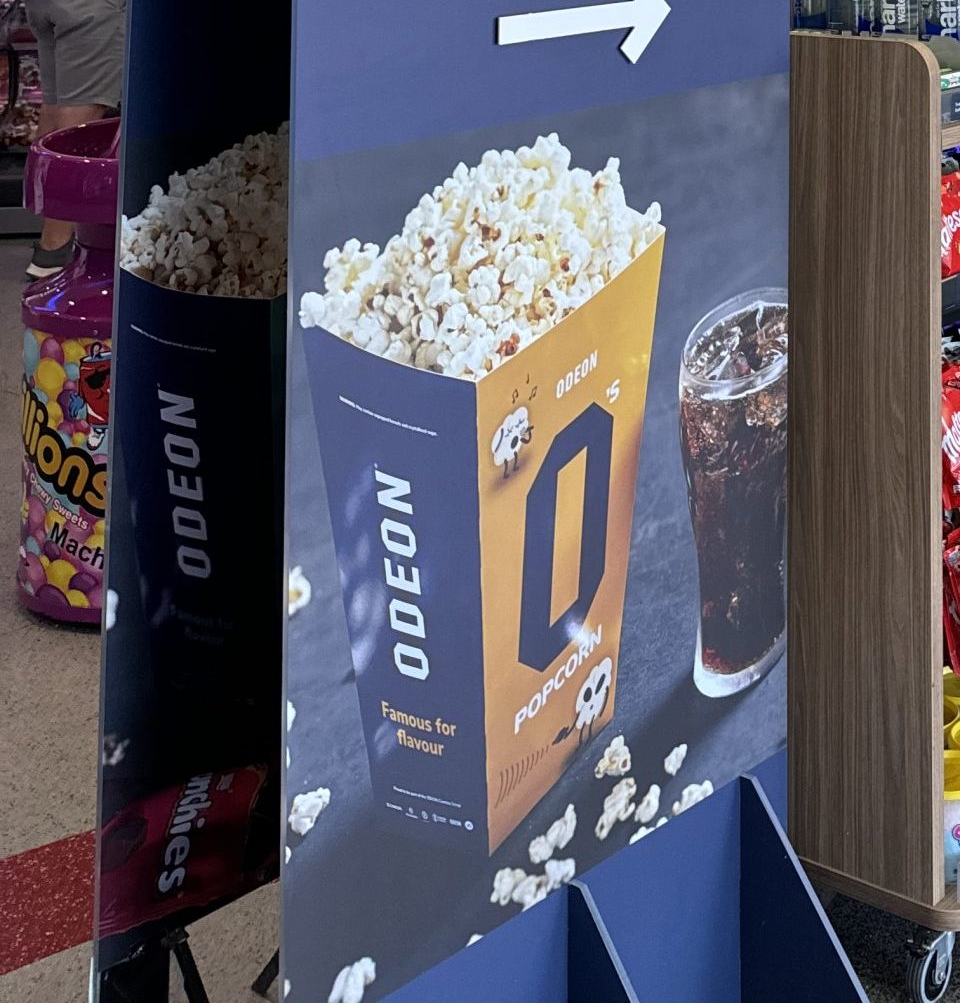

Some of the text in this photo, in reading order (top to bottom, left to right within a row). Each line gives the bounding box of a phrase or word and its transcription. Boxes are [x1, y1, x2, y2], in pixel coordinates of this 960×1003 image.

[555, 350, 598, 399] ODEON
[22, 374, 106, 518] llions
[29, 472, 89, 530] Chewy Sweets
[157, 386, 212, 580] ODEON
[375, 469, 430, 681] ODEON
[381, 700, 457, 737] Famous for
[514, 624, 602, 735] POPCORN
[397, 728, 445, 756] flavour
[159, 772, 213, 895] unchies
